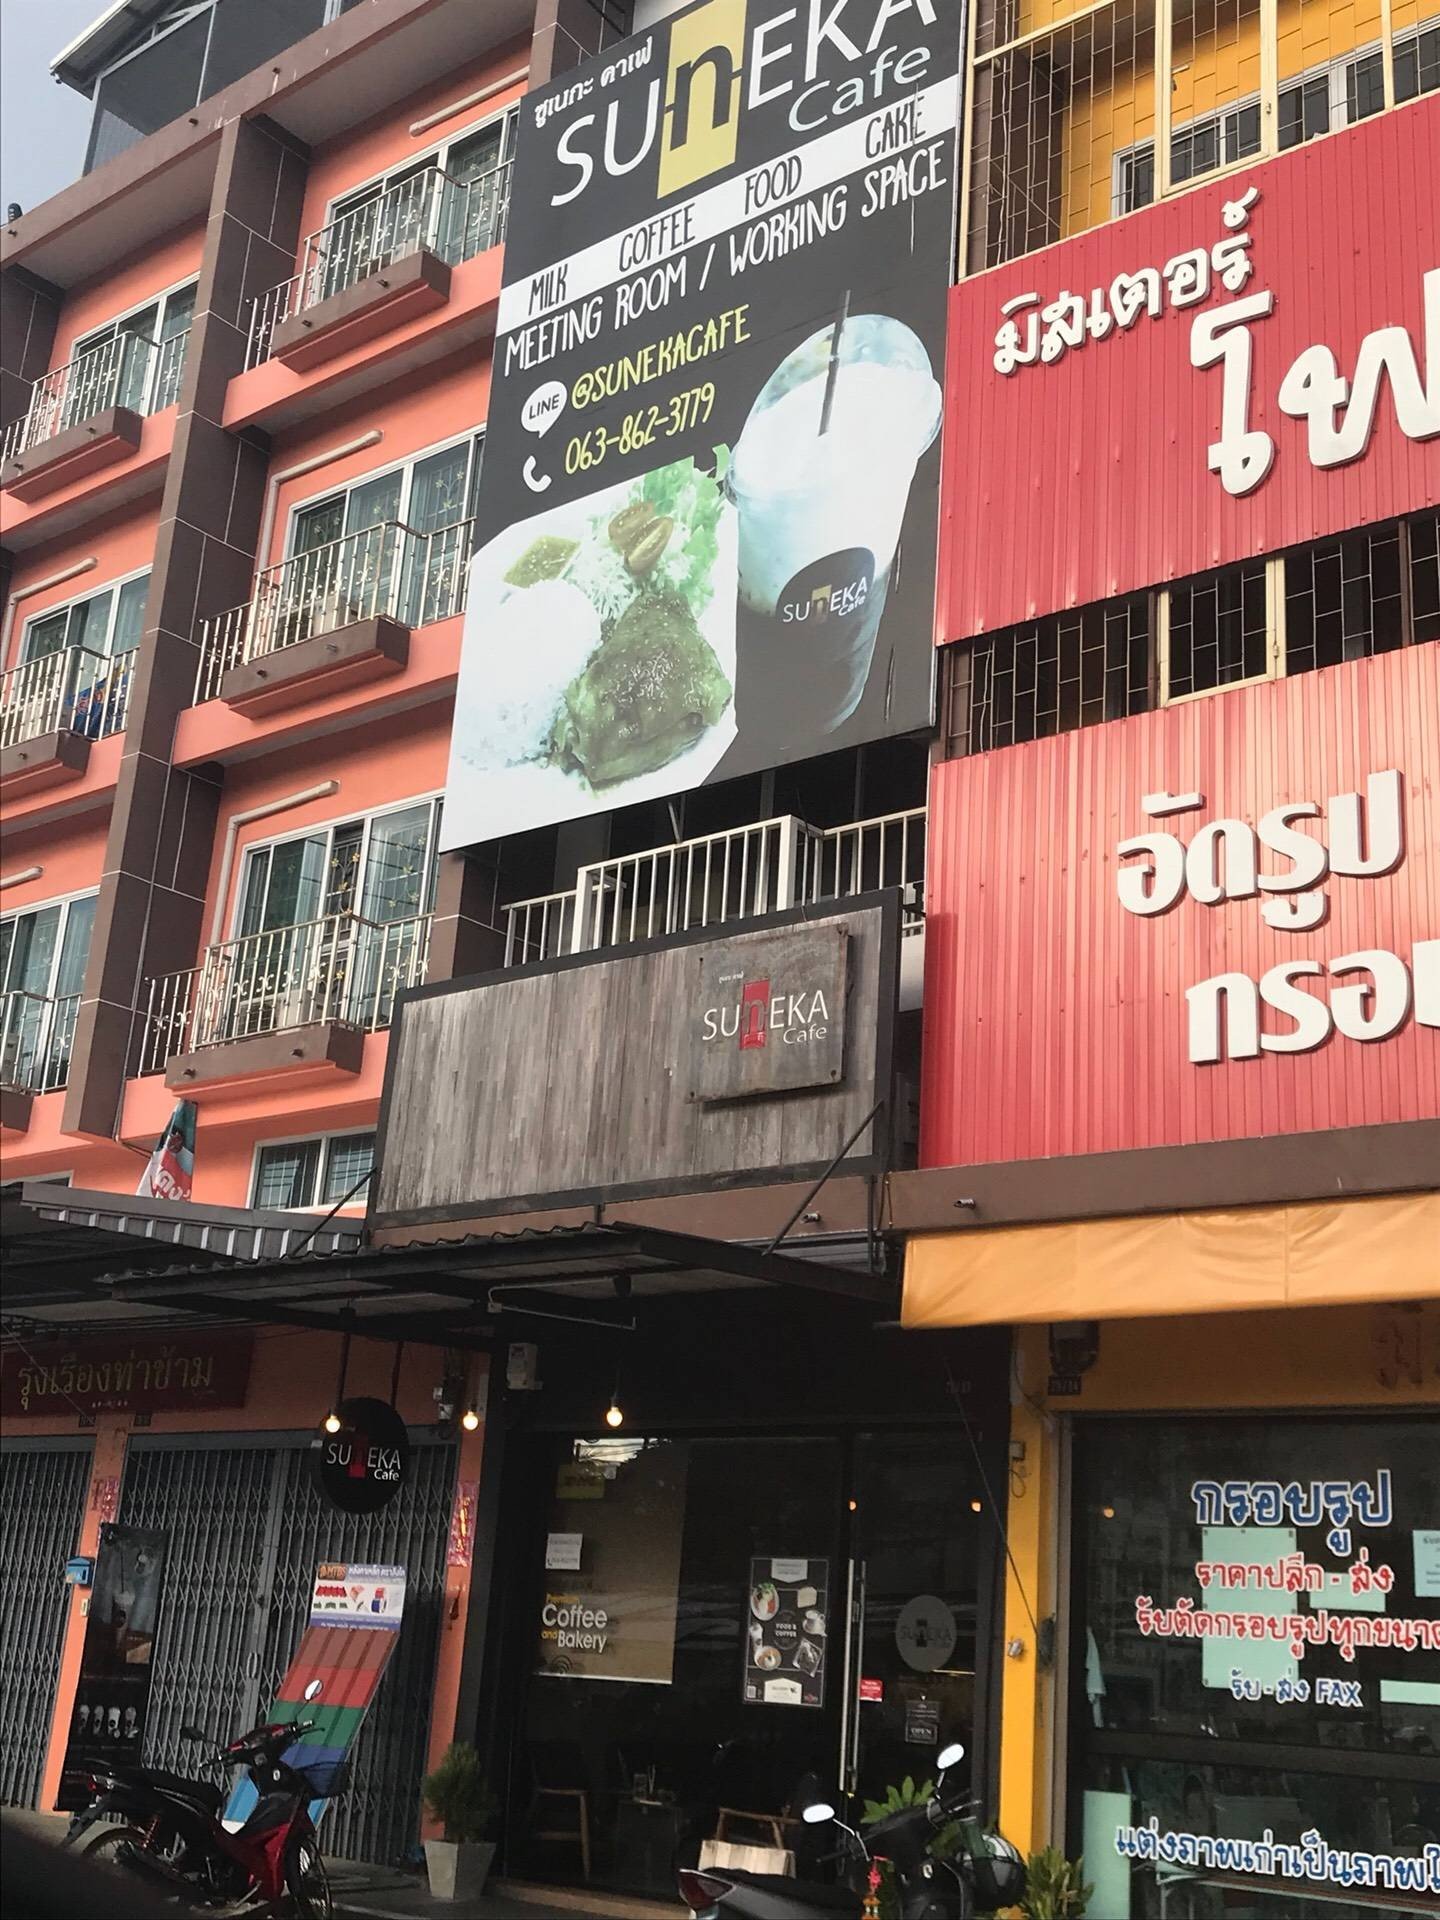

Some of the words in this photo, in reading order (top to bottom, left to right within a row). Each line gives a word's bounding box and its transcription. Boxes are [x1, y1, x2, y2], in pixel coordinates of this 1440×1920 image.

[788, 45, 932, 132] Cafe
[528, 263, 569, 317] MILK
[619, 203, 697, 273] COFFEE
[744, 155, 803, 216] FOOD
[865, 96, 927, 159] CAKE
[504, 296, 604, 377] MEETING
[614, 256, 687, 331] ROOM
[729, 185, 848, 277] WORKING
[861, 140, 948, 218] SPACE
[992, 186, 1264, 377] มิสเตอร์
[571, 304, 751, 410] @SUNEKACAFE
[528, 395, 561, 420] LINE
[564, 382, 716, 476] 063-862-3779
[838, 595, 866, 617] Cafe
[1116, 768, 1408, 933] อัดรูป
[783, 1023, 828, 1045] Cafe
[373, 1468, 400, 1482] Cafe
[1191, 1468, 1394, 1557] กรอบรูป
[542, 1603, 608, 1629] Coffee
[557, 1629, 608, 1654] Bakery
[1315, 1677, 1364, 1708] FAX
